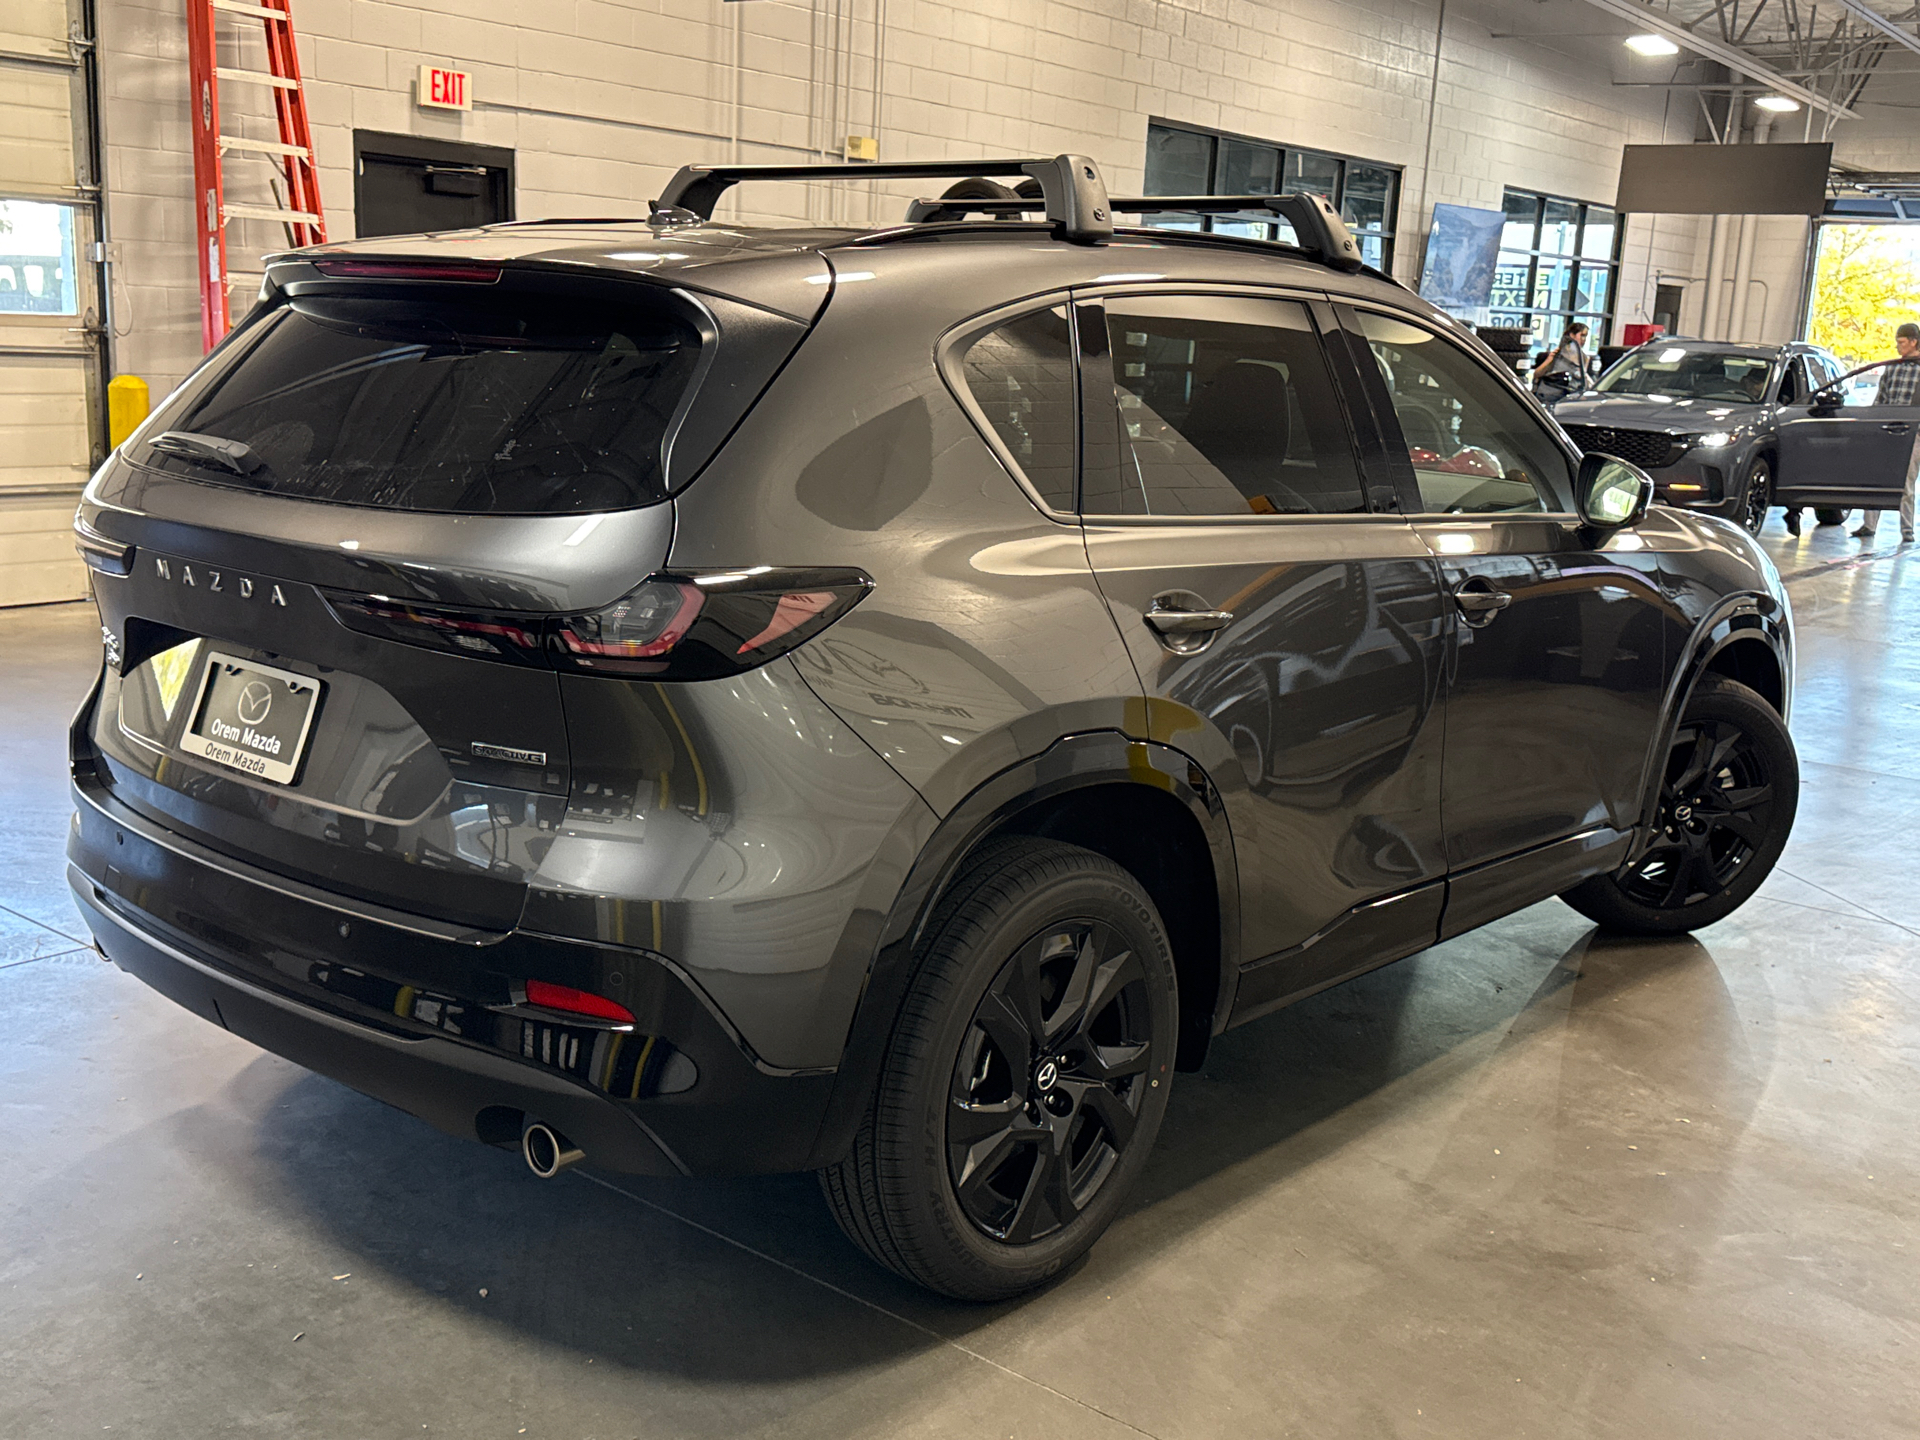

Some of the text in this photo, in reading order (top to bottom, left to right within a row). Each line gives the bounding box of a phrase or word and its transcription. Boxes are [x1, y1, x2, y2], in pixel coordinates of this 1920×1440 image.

[431, 69, 466, 106] EXIT
[156, 558, 287, 607] MAZDA
[211, 718, 281, 754] Orem Mazda
[205, 742, 266, 774] Orem Mazda
[1111, 885, 1176, 992] TOYO TIRES
